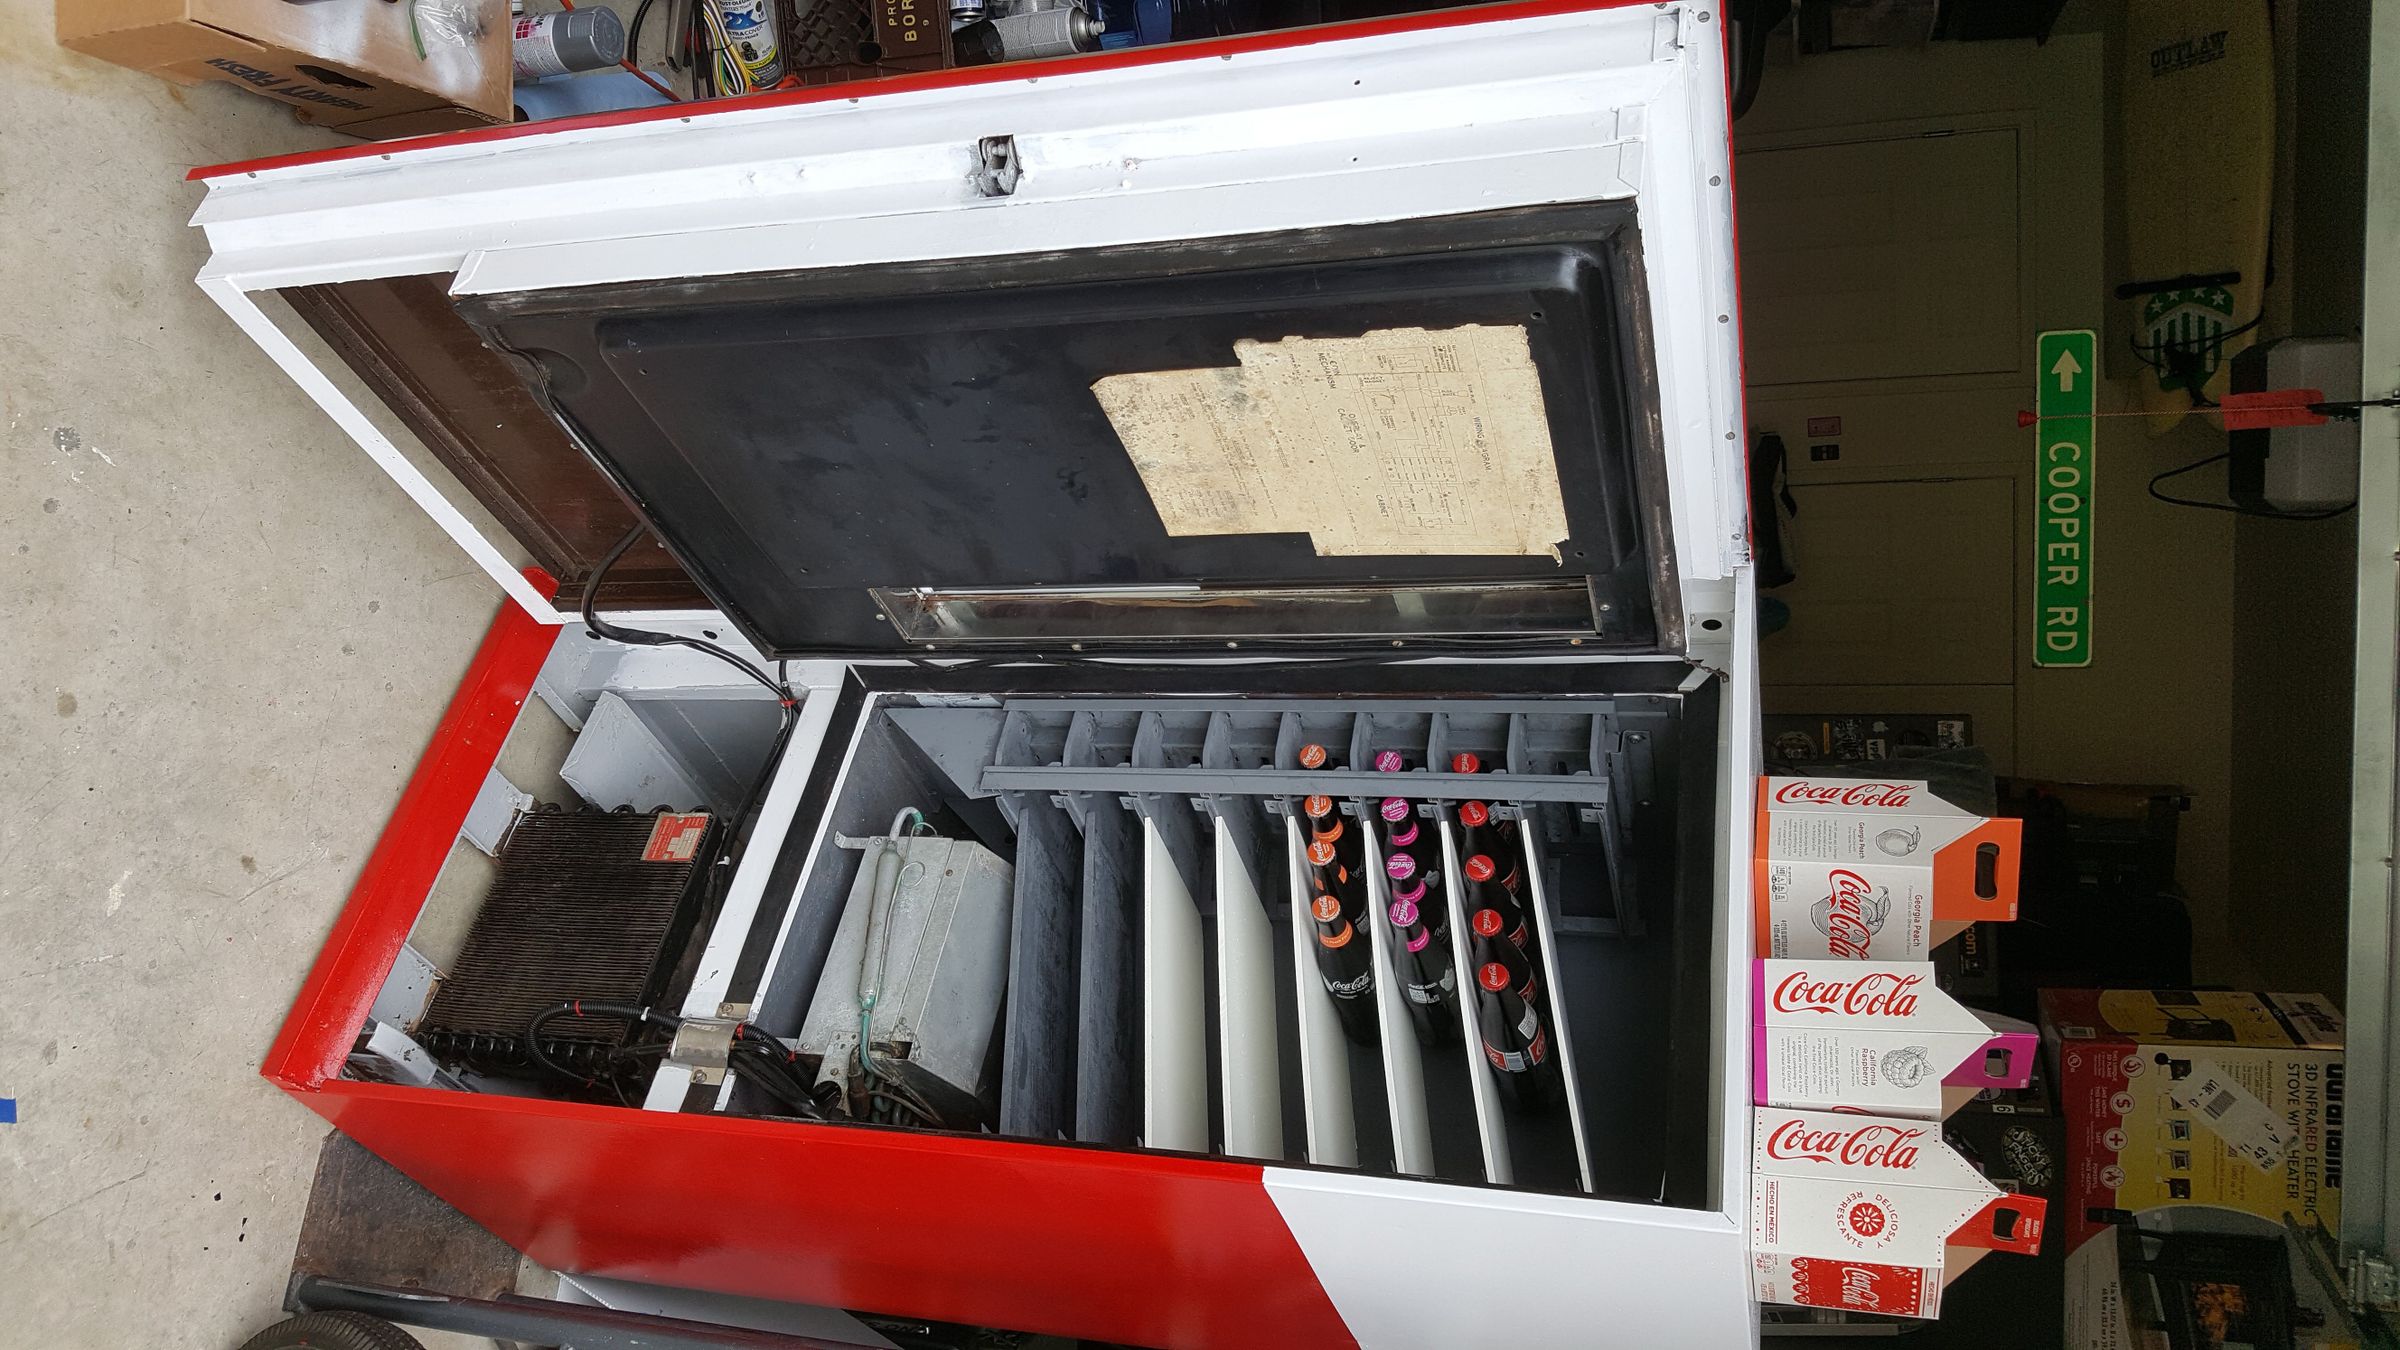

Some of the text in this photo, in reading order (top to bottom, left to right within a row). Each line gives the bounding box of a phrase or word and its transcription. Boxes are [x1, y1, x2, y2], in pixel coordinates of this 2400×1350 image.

[744, 25, 764, 35] COVER
[902, 0, 917, 41] BOR
[2150, 30, 2228, 68] OUTLAW
[205, 58, 291, 87] FRESH
[1318, 352, 1336, 389] MECHANISM
[1336, 408, 1352, 433] CABET
[1473, 416, 1486, 439] WIRING
[1375, 494, 1389, 518] CABINET
[2046, 441, 2081, 651] COOPER RD
[1775, 781, 1920, 807] Coca-Cola
[1398, 900, 1411, 923] Coca-Cola
[1482, 909, 1492, 931] Coca-Cola
[1829, 869, 1872, 960] Coca-Cola
[1913, 894, 1923, 947] Georgia Peach
[1333, 971, 1370, 991] Coca-Cola
[1488, 964, 1497, 986] Coca-Cola
[1773, 972, 1927, 1017] Coca-Cola
[1861, 1048, 1869, 1086] Raspberry
[1869, 1050, 1877, 1086] California
[2287, 1062, 2300, 1105] STOVE
[2187, 1098, 2200, 1109] 43
[2202, 1079, 2220, 1095] LANE
[1766, 1119, 1928, 1170] Coca-Cola
[2012, 1130, 2046, 1165] STICKY
[2254, 1147, 2268, 1159] 43
[2304, 1063, 2318, 1217] 3D INFRARED ELECTRIC
[2009, 1142, 2044, 1185] FINGERS
[2287, 1149, 2300, 1199] HEATER
[1769, 1206, 1774, 1215] EN
[1836, 1191, 1864, 1249] REFRESCANTE
[1875, 1194, 1898, 1249] DELICIOSA Y
[1841, 1266, 1880, 1309] Coca-Cola
